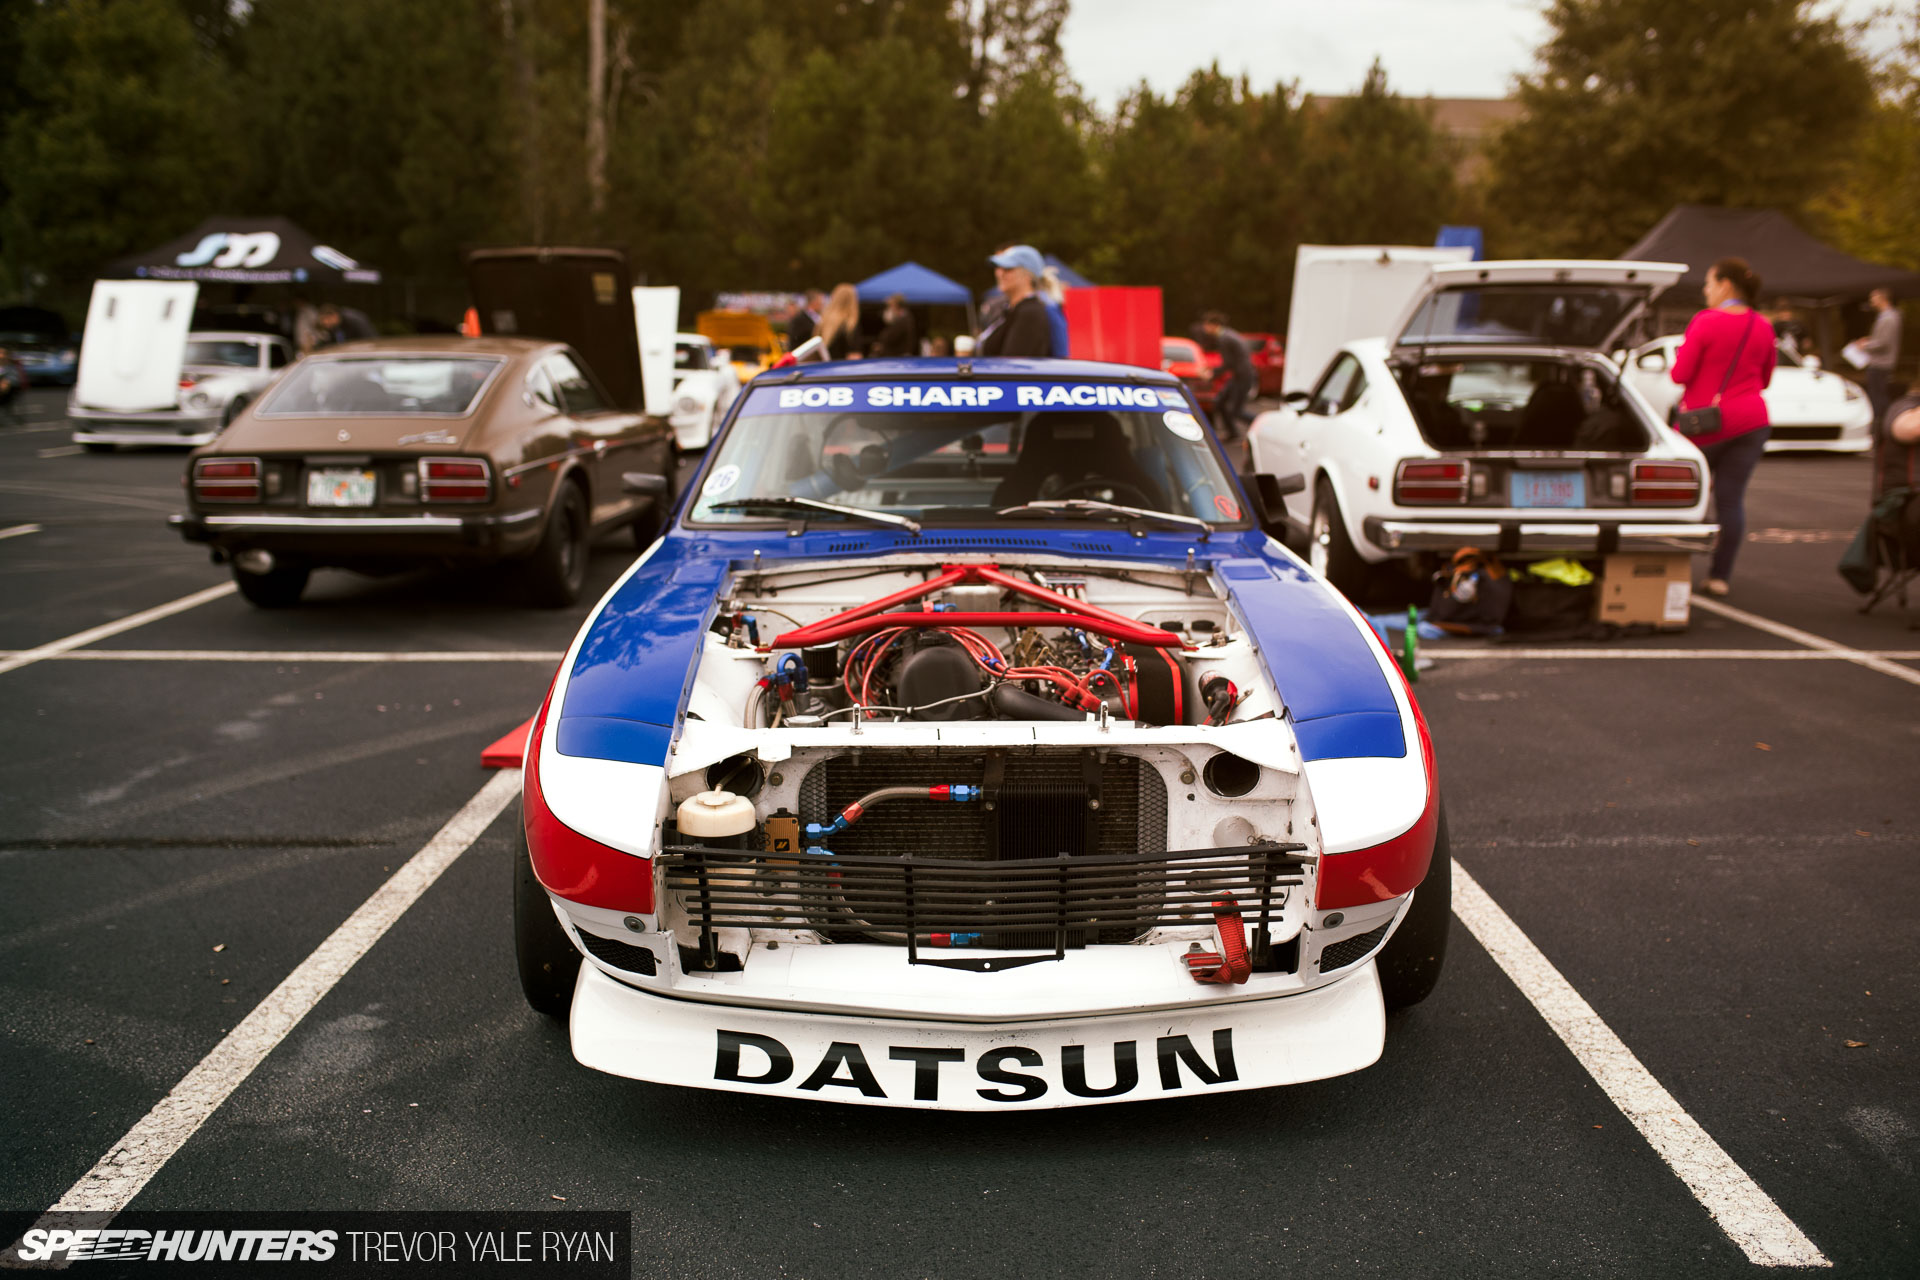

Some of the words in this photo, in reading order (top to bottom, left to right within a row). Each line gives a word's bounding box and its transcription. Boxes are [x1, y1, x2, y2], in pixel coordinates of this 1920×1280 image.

[779, 386, 855, 408] BOB
[867, 386, 1004, 407] SHARP
[1016, 385, 1160, 408] RACING
[713, 1026, 1240, 1103] DATSUN
